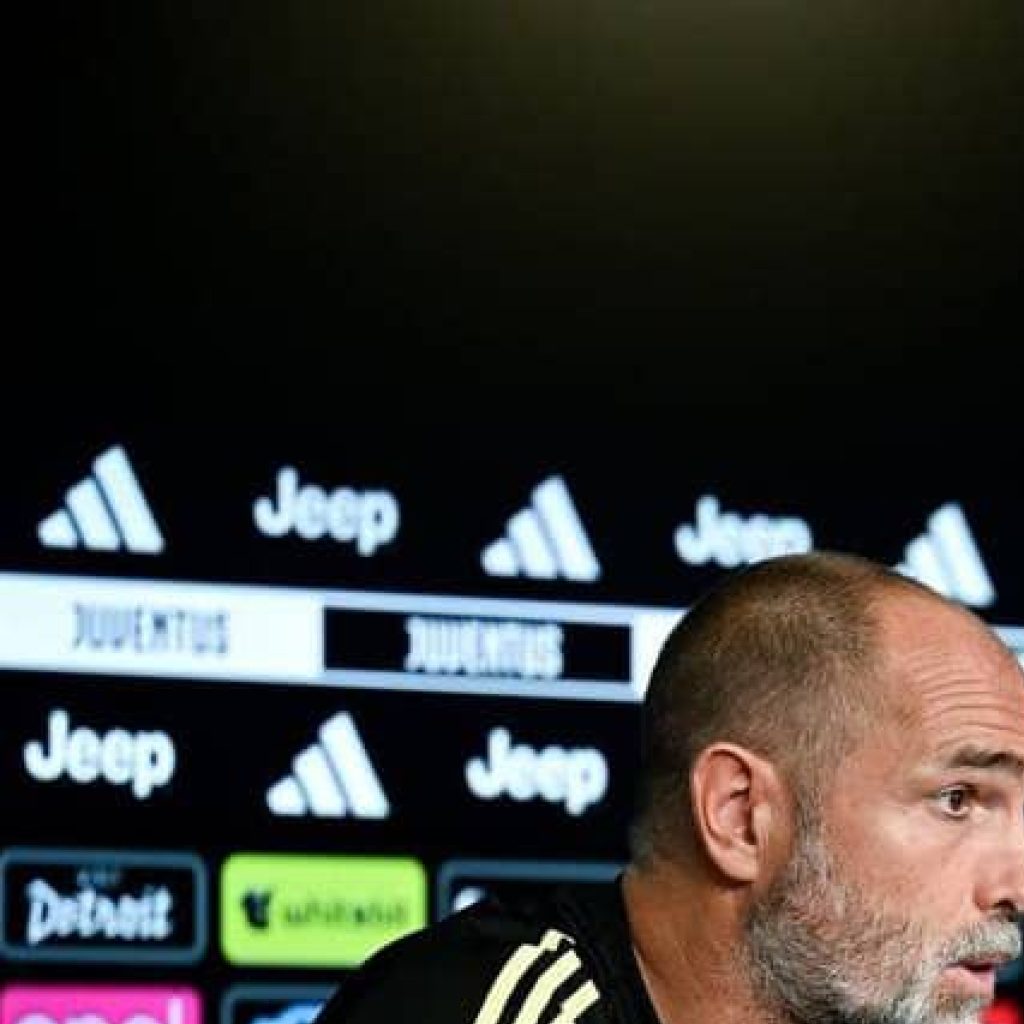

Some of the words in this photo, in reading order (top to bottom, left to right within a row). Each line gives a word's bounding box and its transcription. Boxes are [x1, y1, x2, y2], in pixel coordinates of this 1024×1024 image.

[253, 467, 400, 556] Jeep
[24, 709, 176, 798] Jeep
[465, 727, 609, 816] Jeep
